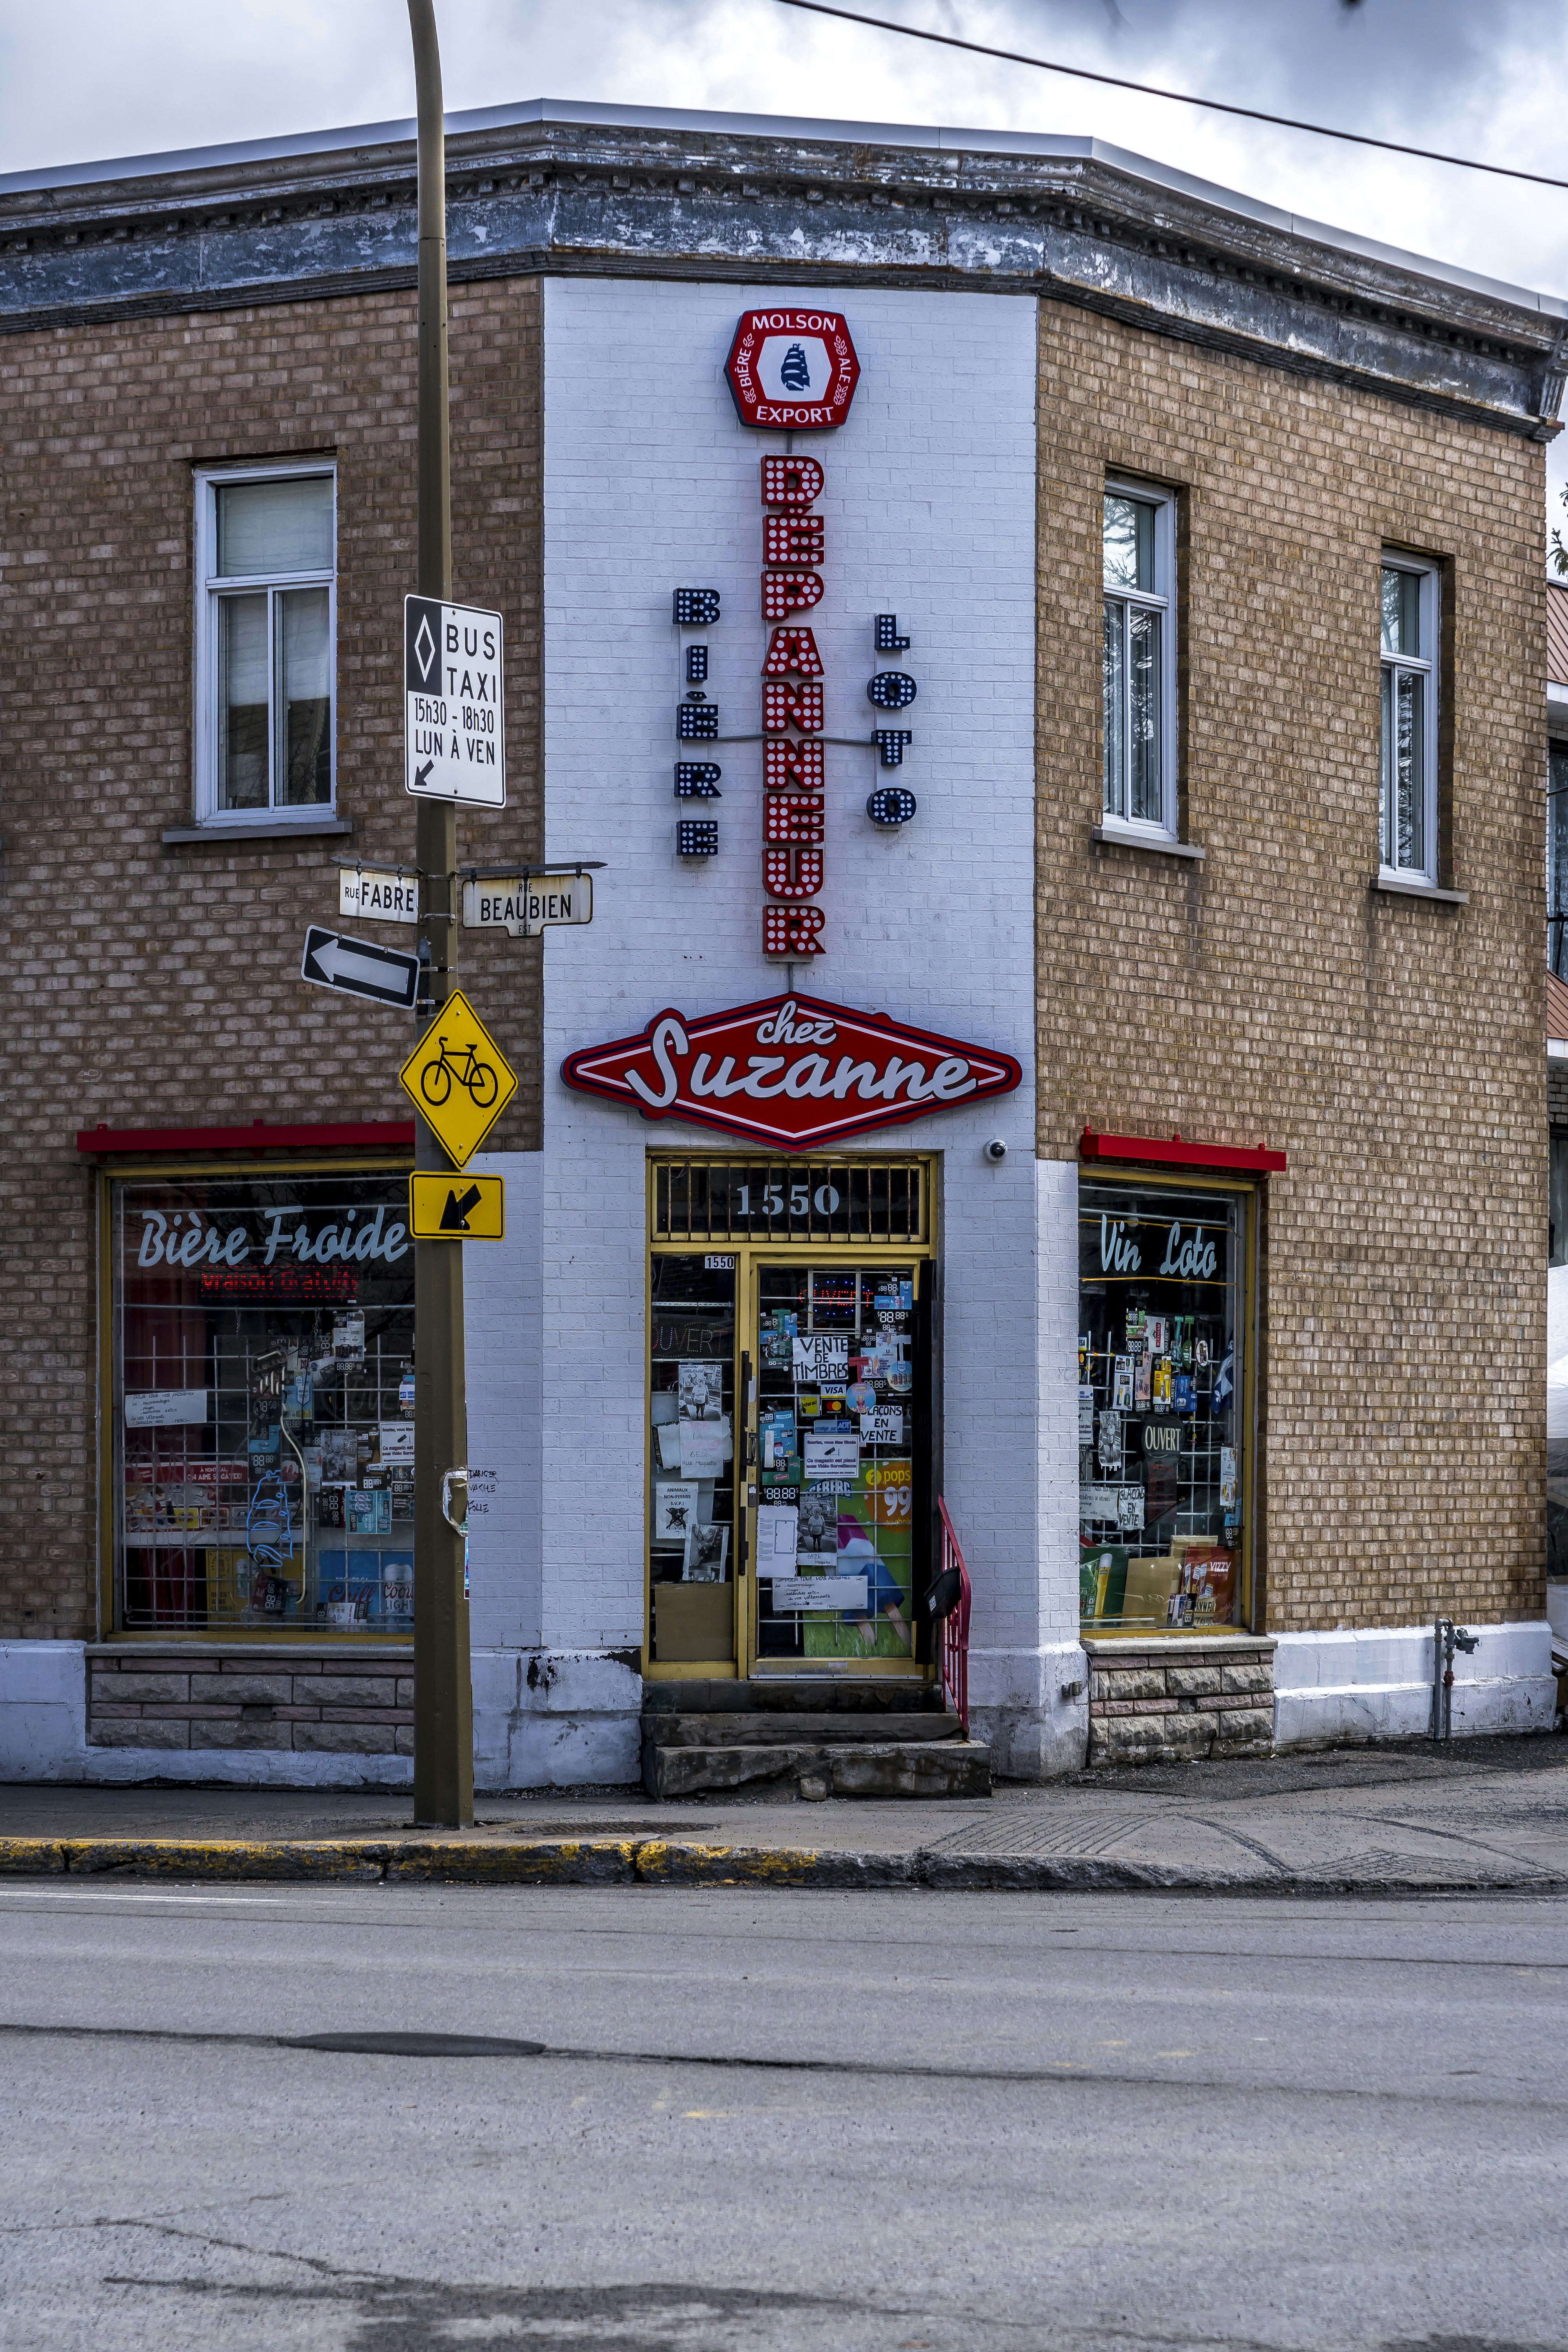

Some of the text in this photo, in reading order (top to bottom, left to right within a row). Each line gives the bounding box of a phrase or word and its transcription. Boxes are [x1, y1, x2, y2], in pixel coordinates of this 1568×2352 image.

[753, 314, 837, 332] MOLSON
[737, 347, 751, 387] BIÈRE
[839, 358, 851, 385] ALE
[757, 406, 834, 423] EXPORT
[446, 624, 495, 661] BUS
[447, 666, 496, 703] TAXI
[414, 697, 447, 726] 15h30
[462, 705, 494, 734] 18h30
[760, 455, 826, 955] DÉPANNEUR
[672, 588, 722, 856] BIÈRE
[866, 613, 917, 825] LOTO
[416, 729, 495, 765] LUN À VEN
[345, 881, 414, 912] RUE FABRE
[518, 883, 532, 893] RUE
[481, 894, 572, 922] BEAUBIEN
[518, 925, 532, 935] EST
[755, 1000, 837, 1045] chez
[624, 1017, 977, 1108] Suzanne
[737, 1185, 839, 1215] 1550
[138, 1205, 408, 1267] Bière Froide
[1102, 1214, 1216, 1278] Vin Loto
[707, 1257, 733, 1268] 1550
[799, 1337, 848, 1354] VENTE
[815, 1353, 829, 1363] DE
[861, 1430, 897, 1442] VENTE
[874, 1418, 889, 1428] EN
[1145, 1426, 1181, 1452] OUVERT
[884, 1469, 911, 1486] pops
[884, 1486, 910, 1517] 99
[1120, 1487, 1145, 1502] GLAÇONS
[1127, 1502, 1136, 1514] EN
[1119, 1513, 1139, 1526] VENTE
[1210, 1561, 1231, 1572] VIZZY
[328, 1584, 377, 1604] Chill
